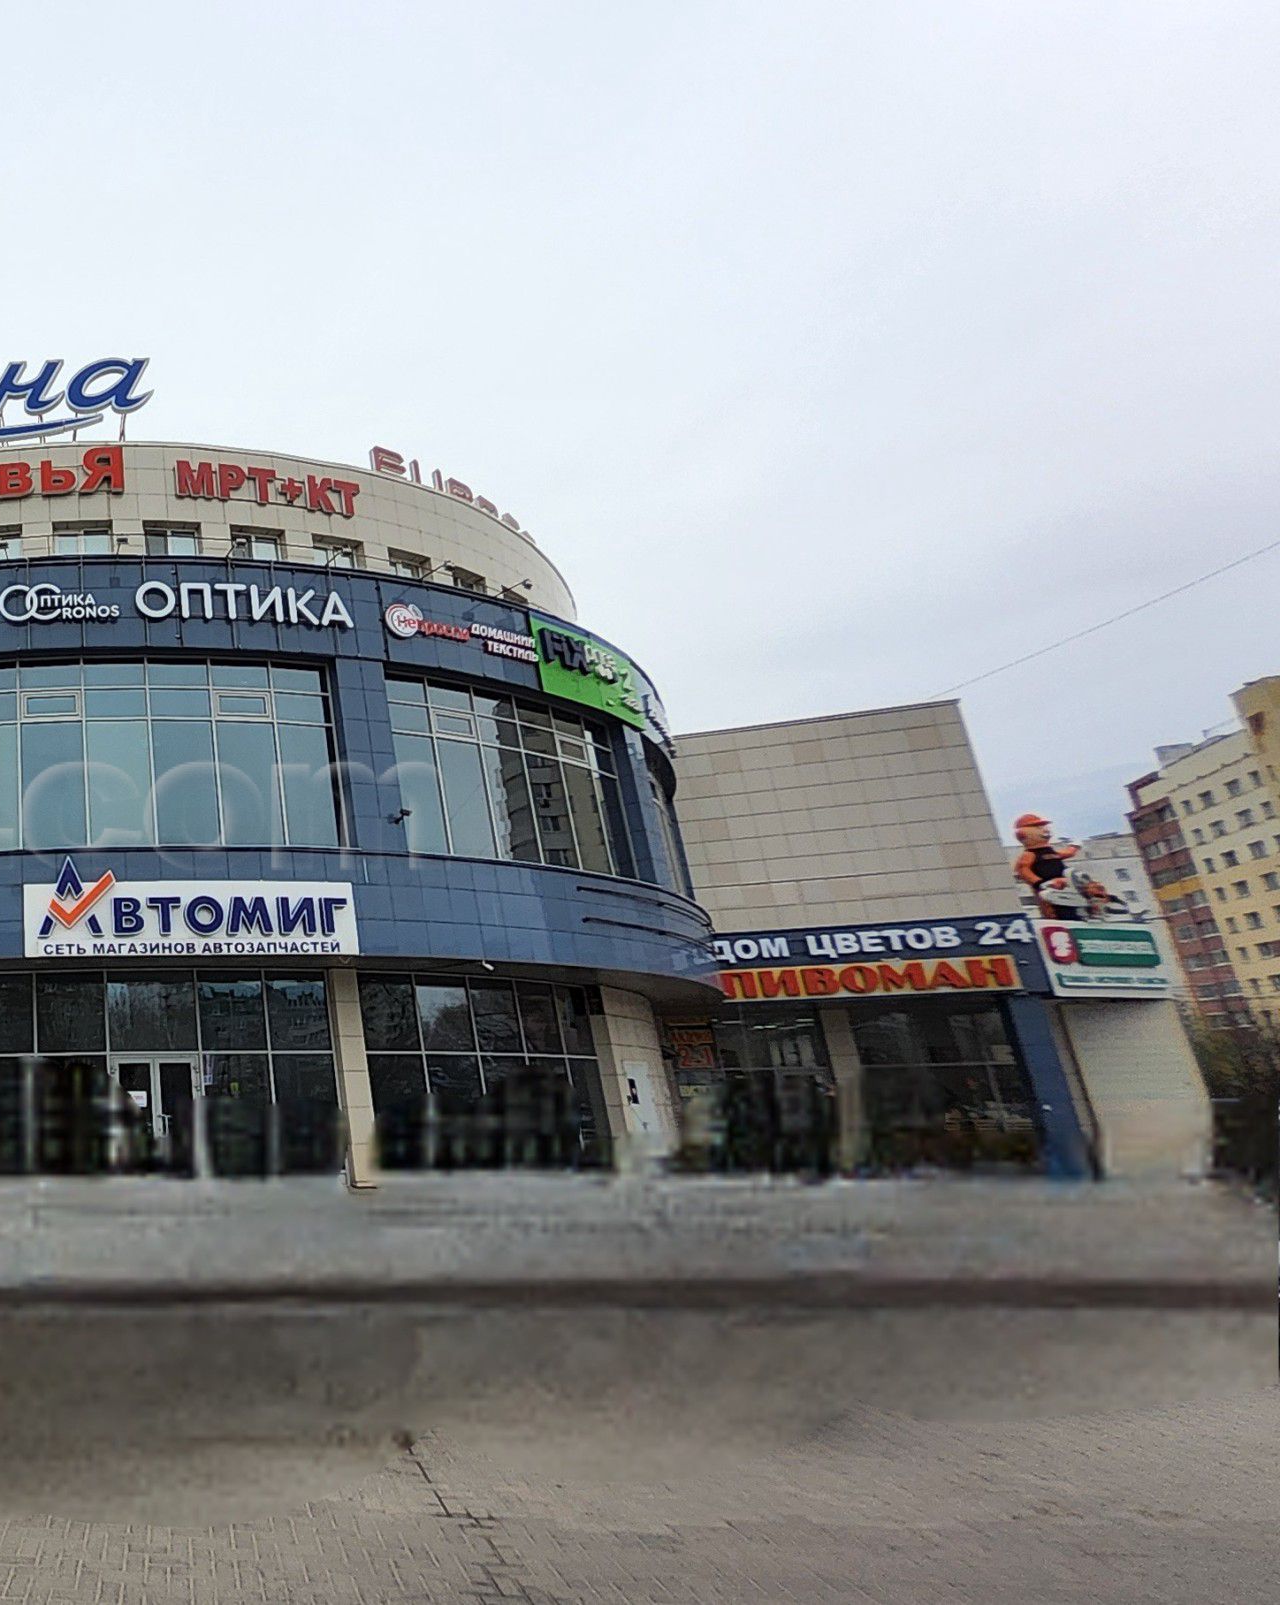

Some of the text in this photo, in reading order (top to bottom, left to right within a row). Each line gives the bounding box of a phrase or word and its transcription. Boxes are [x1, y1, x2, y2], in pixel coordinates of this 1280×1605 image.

[175, 459, 360, 518] МРТ+КТ
[135, 580, 355, 630] ОПТИКА
[471, 622, 536, 649] ДОМАШНИЙ
[487, 640, 539, 663] ТЕКСТИЛЬ
[37, 854, 348, 938] АВТОМИГ
[43, 938, 342, 956] СЕТЬ МАГАЗИНОВ АВТОЗАПЧАСТЕЙ
[712, 919, 1035, 963] ДОМ ЦВЕТОВ 24
[722, 957, 1016, 999] ПИВОМАН
